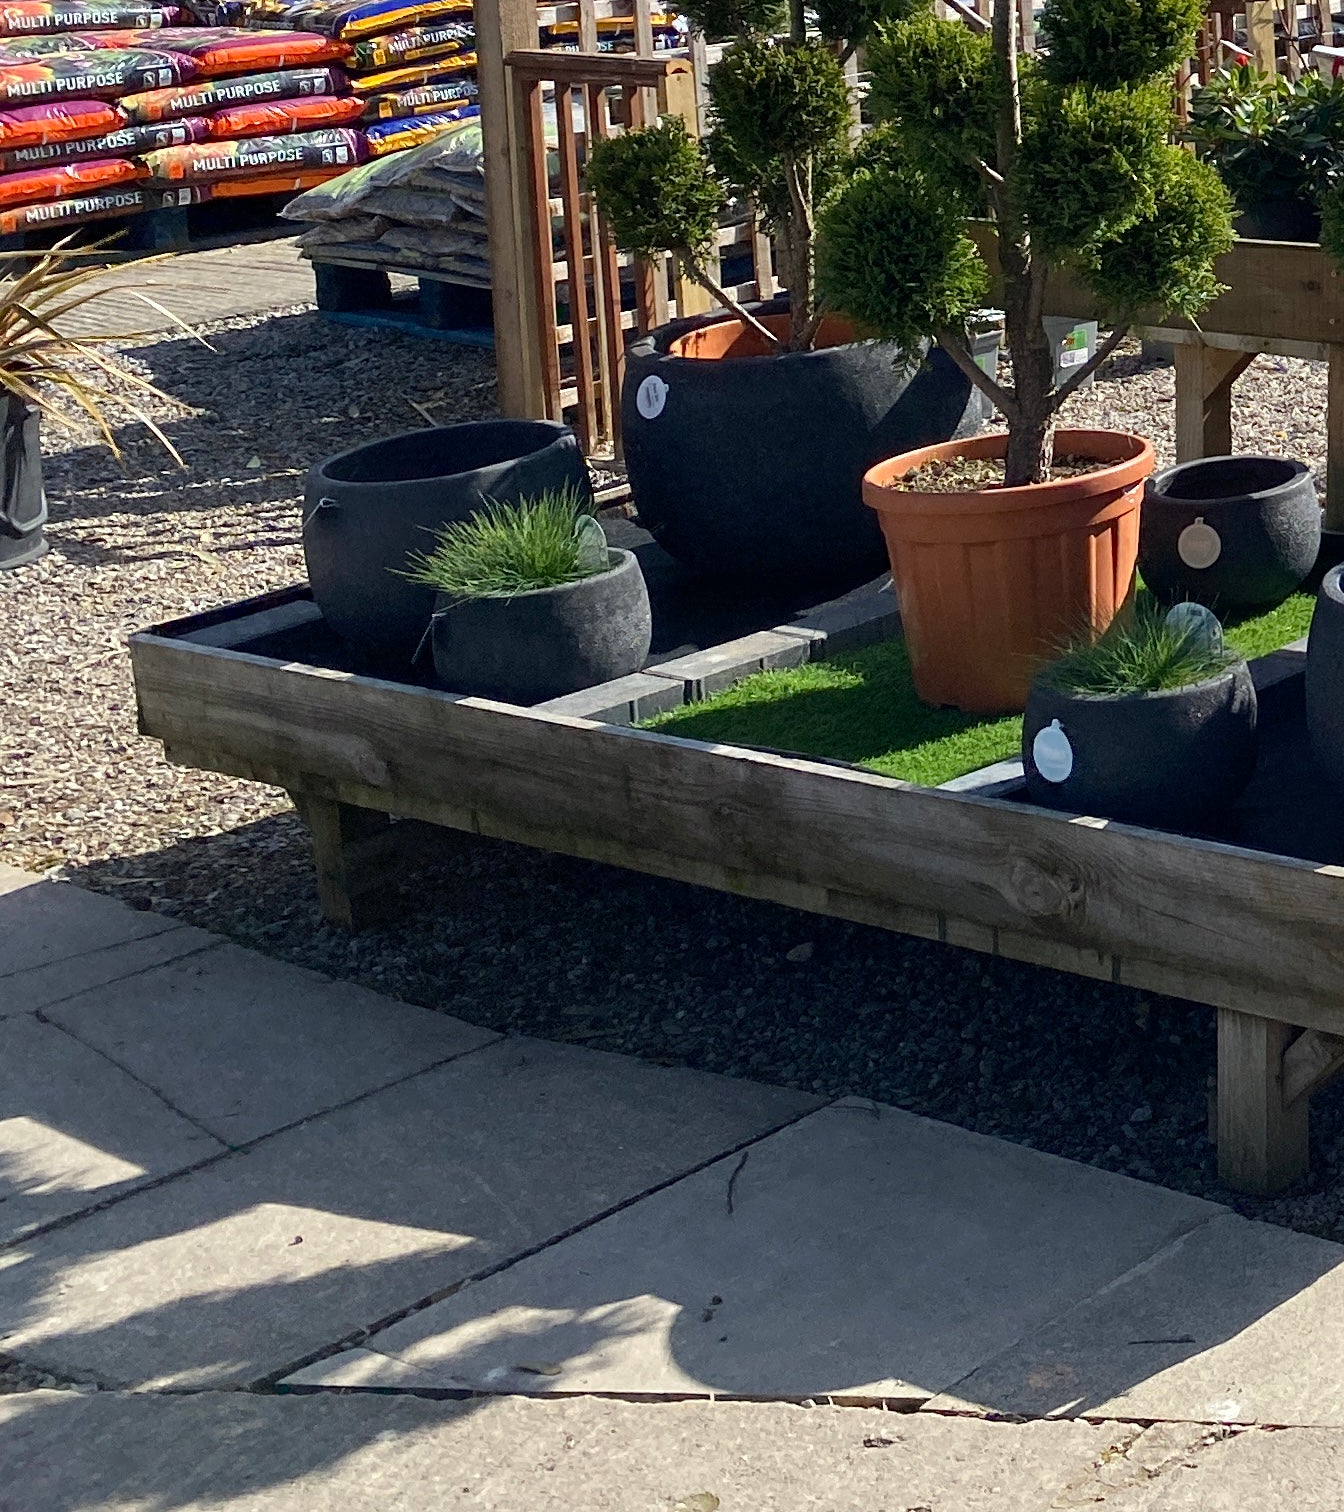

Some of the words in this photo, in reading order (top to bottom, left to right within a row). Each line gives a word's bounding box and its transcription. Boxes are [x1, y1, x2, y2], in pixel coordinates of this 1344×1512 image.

[8, 14, 51, 30] MULTI
[55, 12, 119, 27] PURPOSE
[7, 80, 52, 97] MULTI
[56, 72, 124, 91] PURPOSE
[170, 92, 212, 111] MULTI
[217, 80, 281, 101] PURPOSE
[397, 93, 430, 108] MULTI
[432, 86, 479, 102] PURPOS
[15, 144, 60, 161] MULTI
[66, 132, 137, 155] PURPOSE
[193, 156, 236, 171] MULTI
[240, 148, 303, 167] PURPOSE
[25, 204, 70, 223] MULTI
[75, 192, 143, 214] PURPOSE
